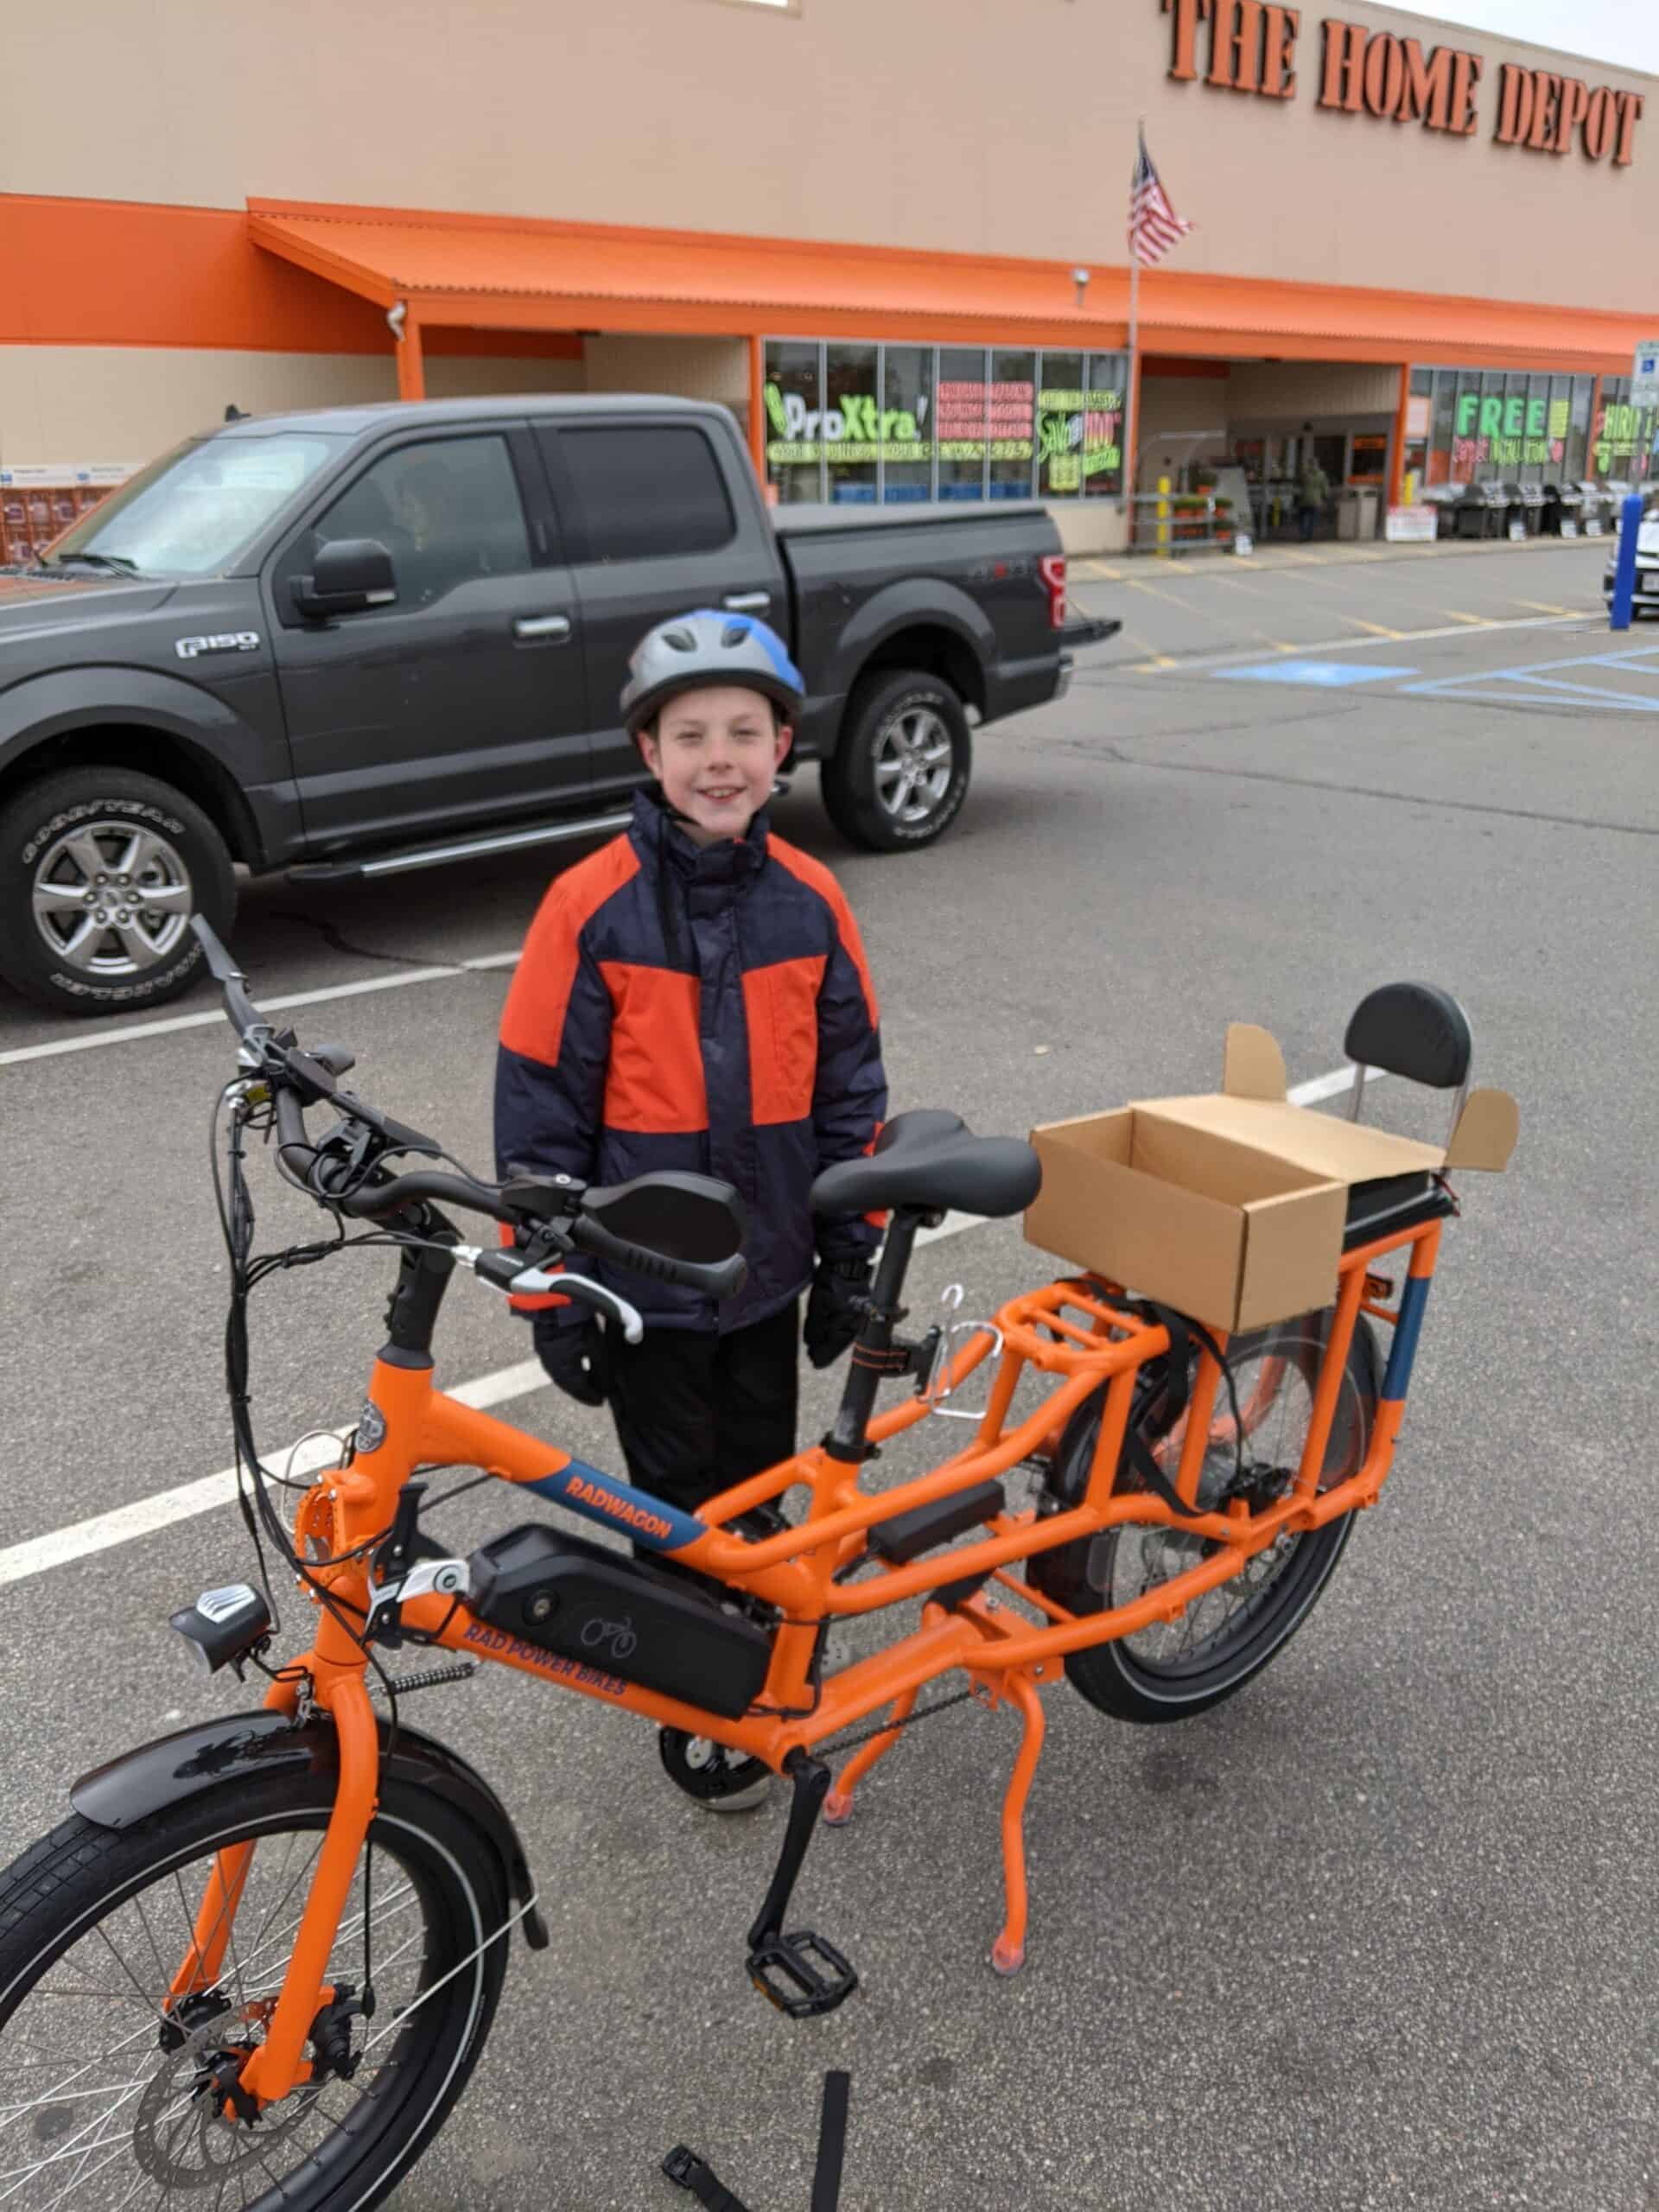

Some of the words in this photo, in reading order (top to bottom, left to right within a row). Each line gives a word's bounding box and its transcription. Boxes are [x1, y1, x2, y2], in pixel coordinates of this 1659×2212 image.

[1160, 0, 1300, 98] THE
[1318, 19, 1483, 136] HOME
[1493, 63, 1645, 167] DEPOT
[1457, 396, 1546, 442] FREE
[565, 1476, 673, 1538] RADWAGON
[465, 1623, 505, 1650] RAD
[507, 1637, 575, 1677] POWER
[576, 1666, 626, 1696] BIKES
